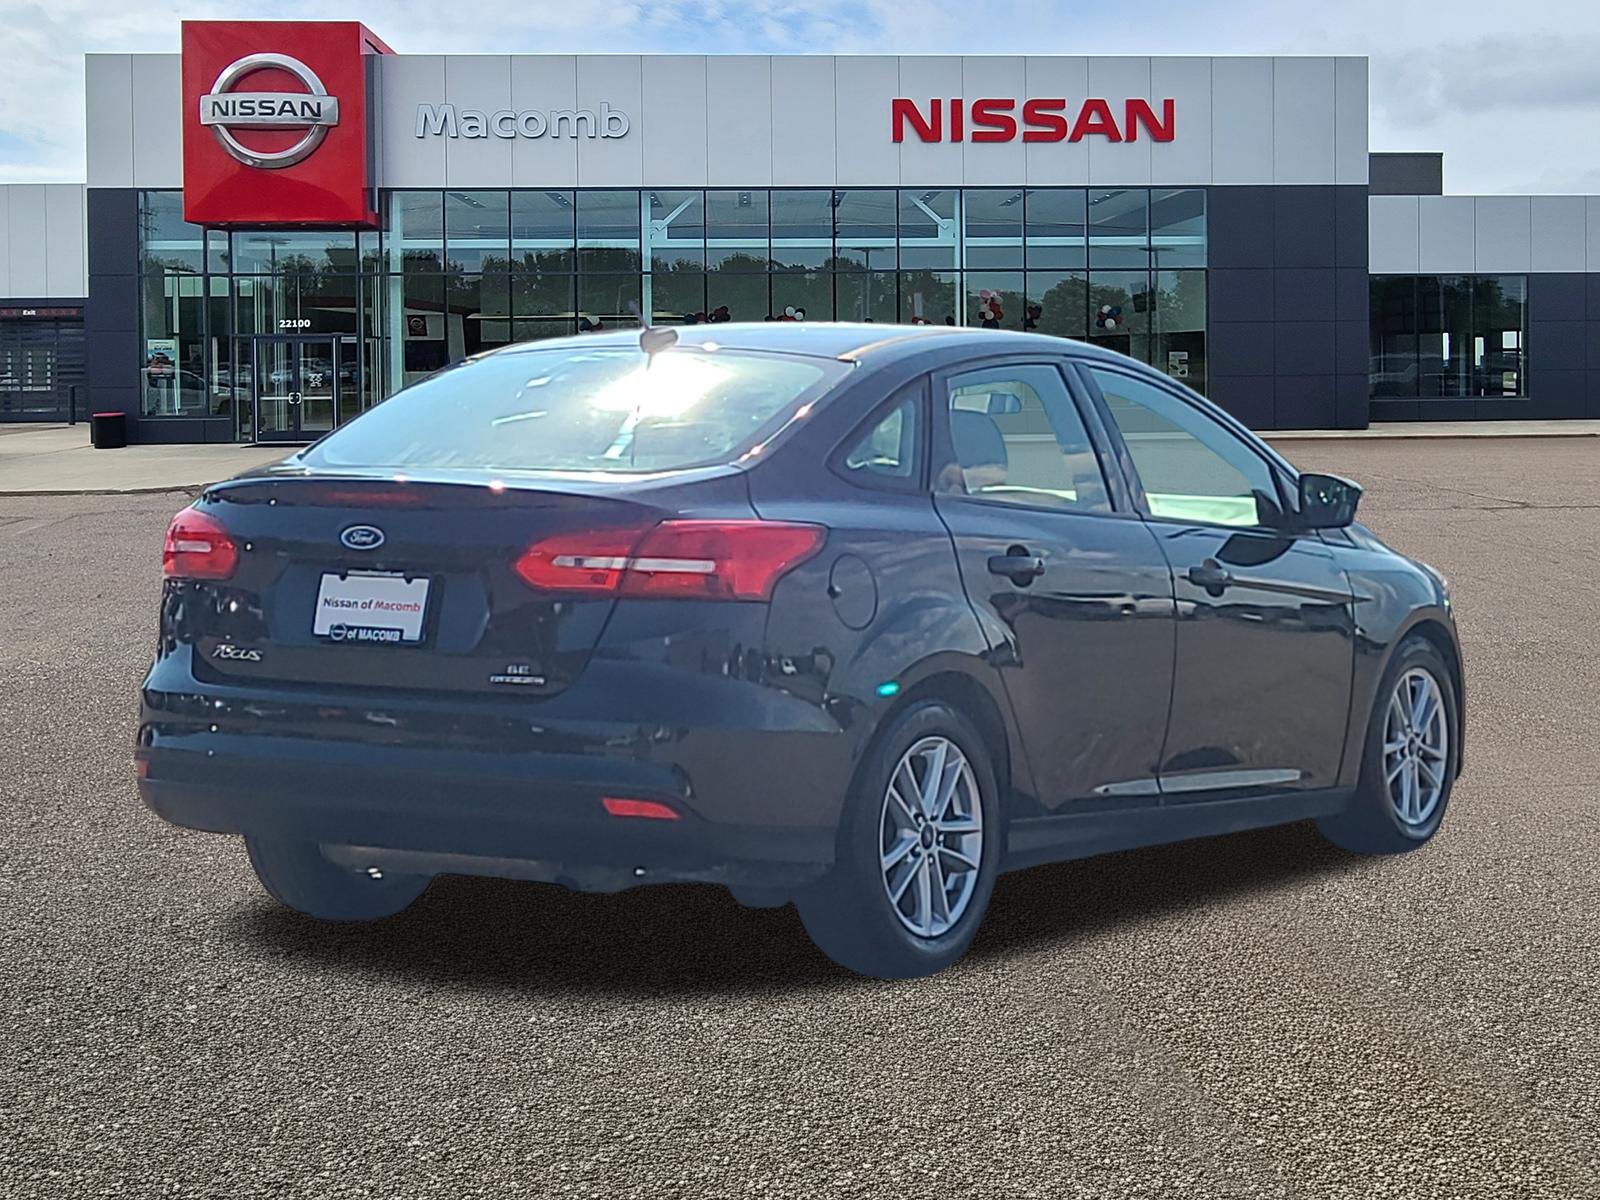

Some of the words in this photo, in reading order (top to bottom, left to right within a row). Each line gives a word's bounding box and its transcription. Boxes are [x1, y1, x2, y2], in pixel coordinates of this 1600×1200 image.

[211, 99, 322, 118] NISSAN
[415, 102, 630, 139] Macomb
[892, 98, 1175, 143] NISSAN
[279, 319, 311, 328] 22100
[350, 530, 375, 543] Ford
[323, 597, 359, 610] Nissan
[360, 599, 374, 610] of
[374, 600, 421, 613] Macomb
[347, 628, 357, 640] of
[358, 628, 401, 641] MACOMB
